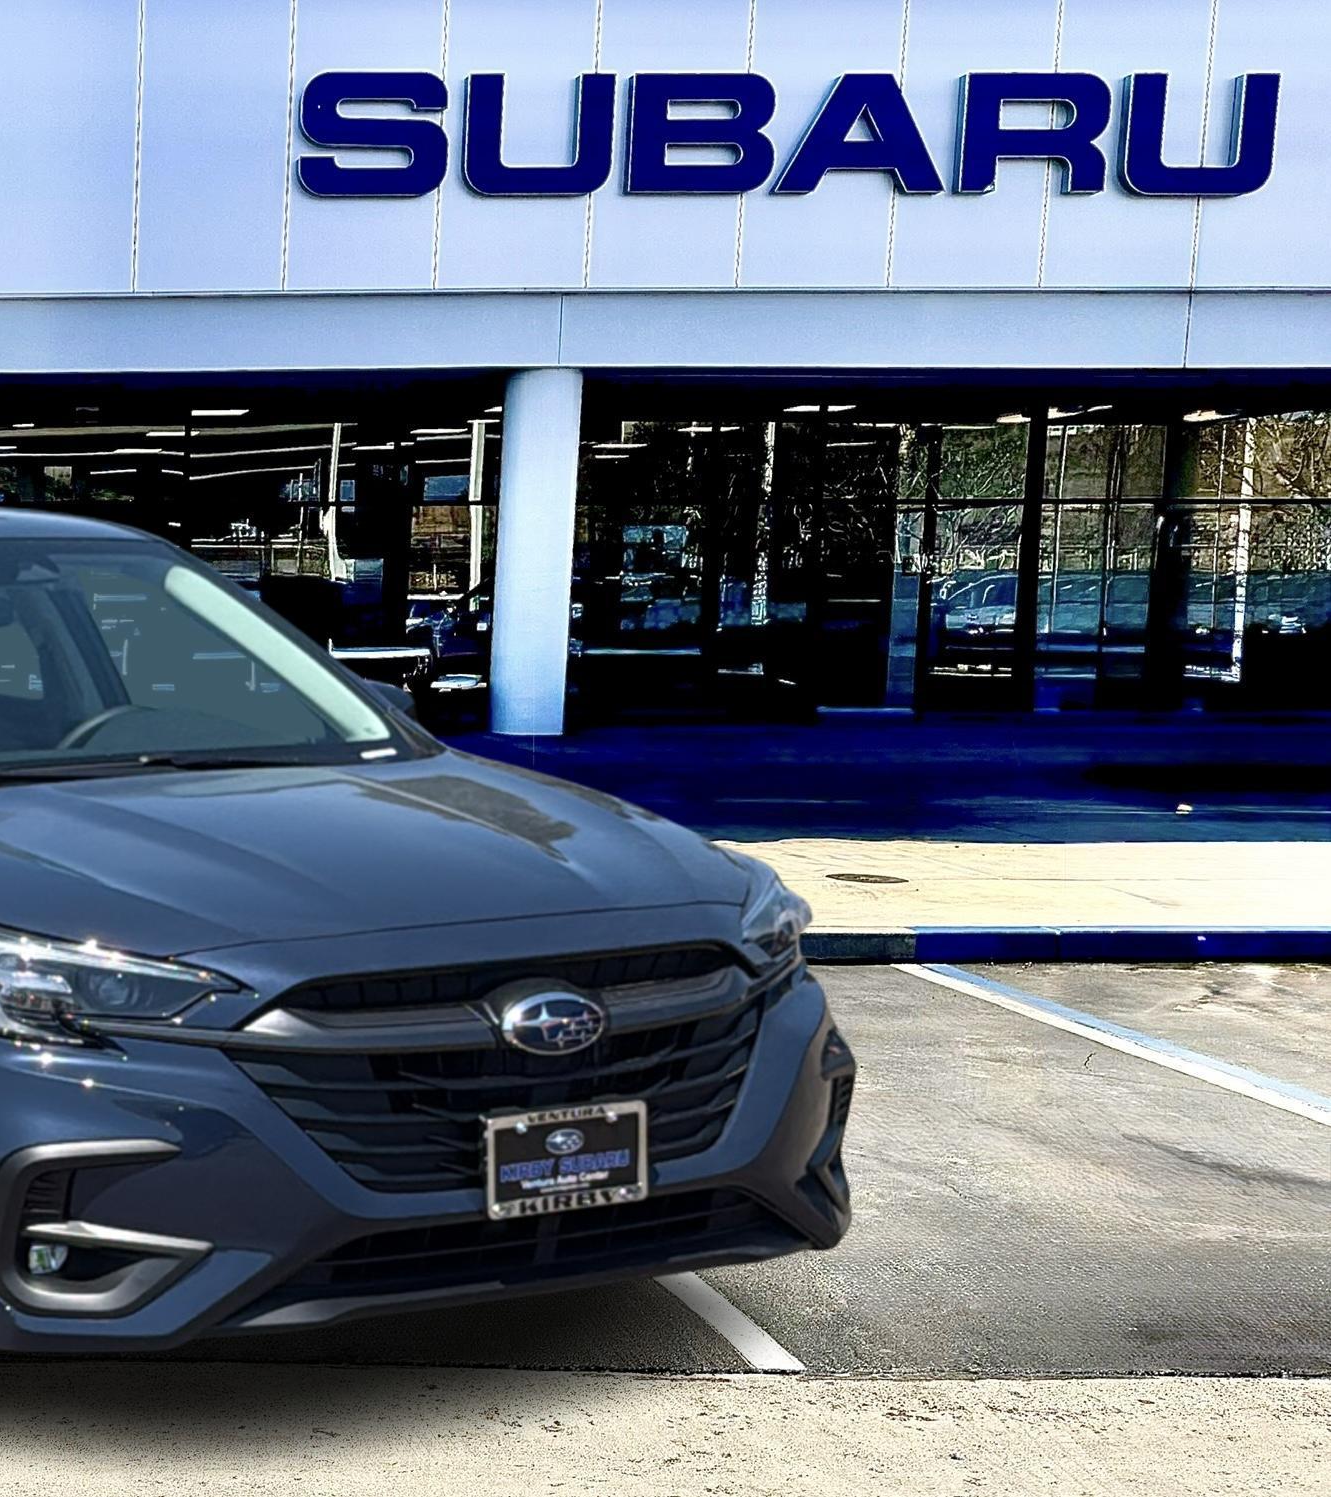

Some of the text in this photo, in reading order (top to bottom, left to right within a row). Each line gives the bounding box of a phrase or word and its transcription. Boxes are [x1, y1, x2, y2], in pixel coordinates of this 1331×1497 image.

[296, 72, 1281, 199] SUBARU
[527, 1106, 606, 1123] VENTURA
[500, 1149, 631, 1183] KIRBY SUBARU
[556, 1174, 578, 1185] Auto
[579, 1170, 609, 1182] Center
[520, 1191, 619, 1214] KIRBY
